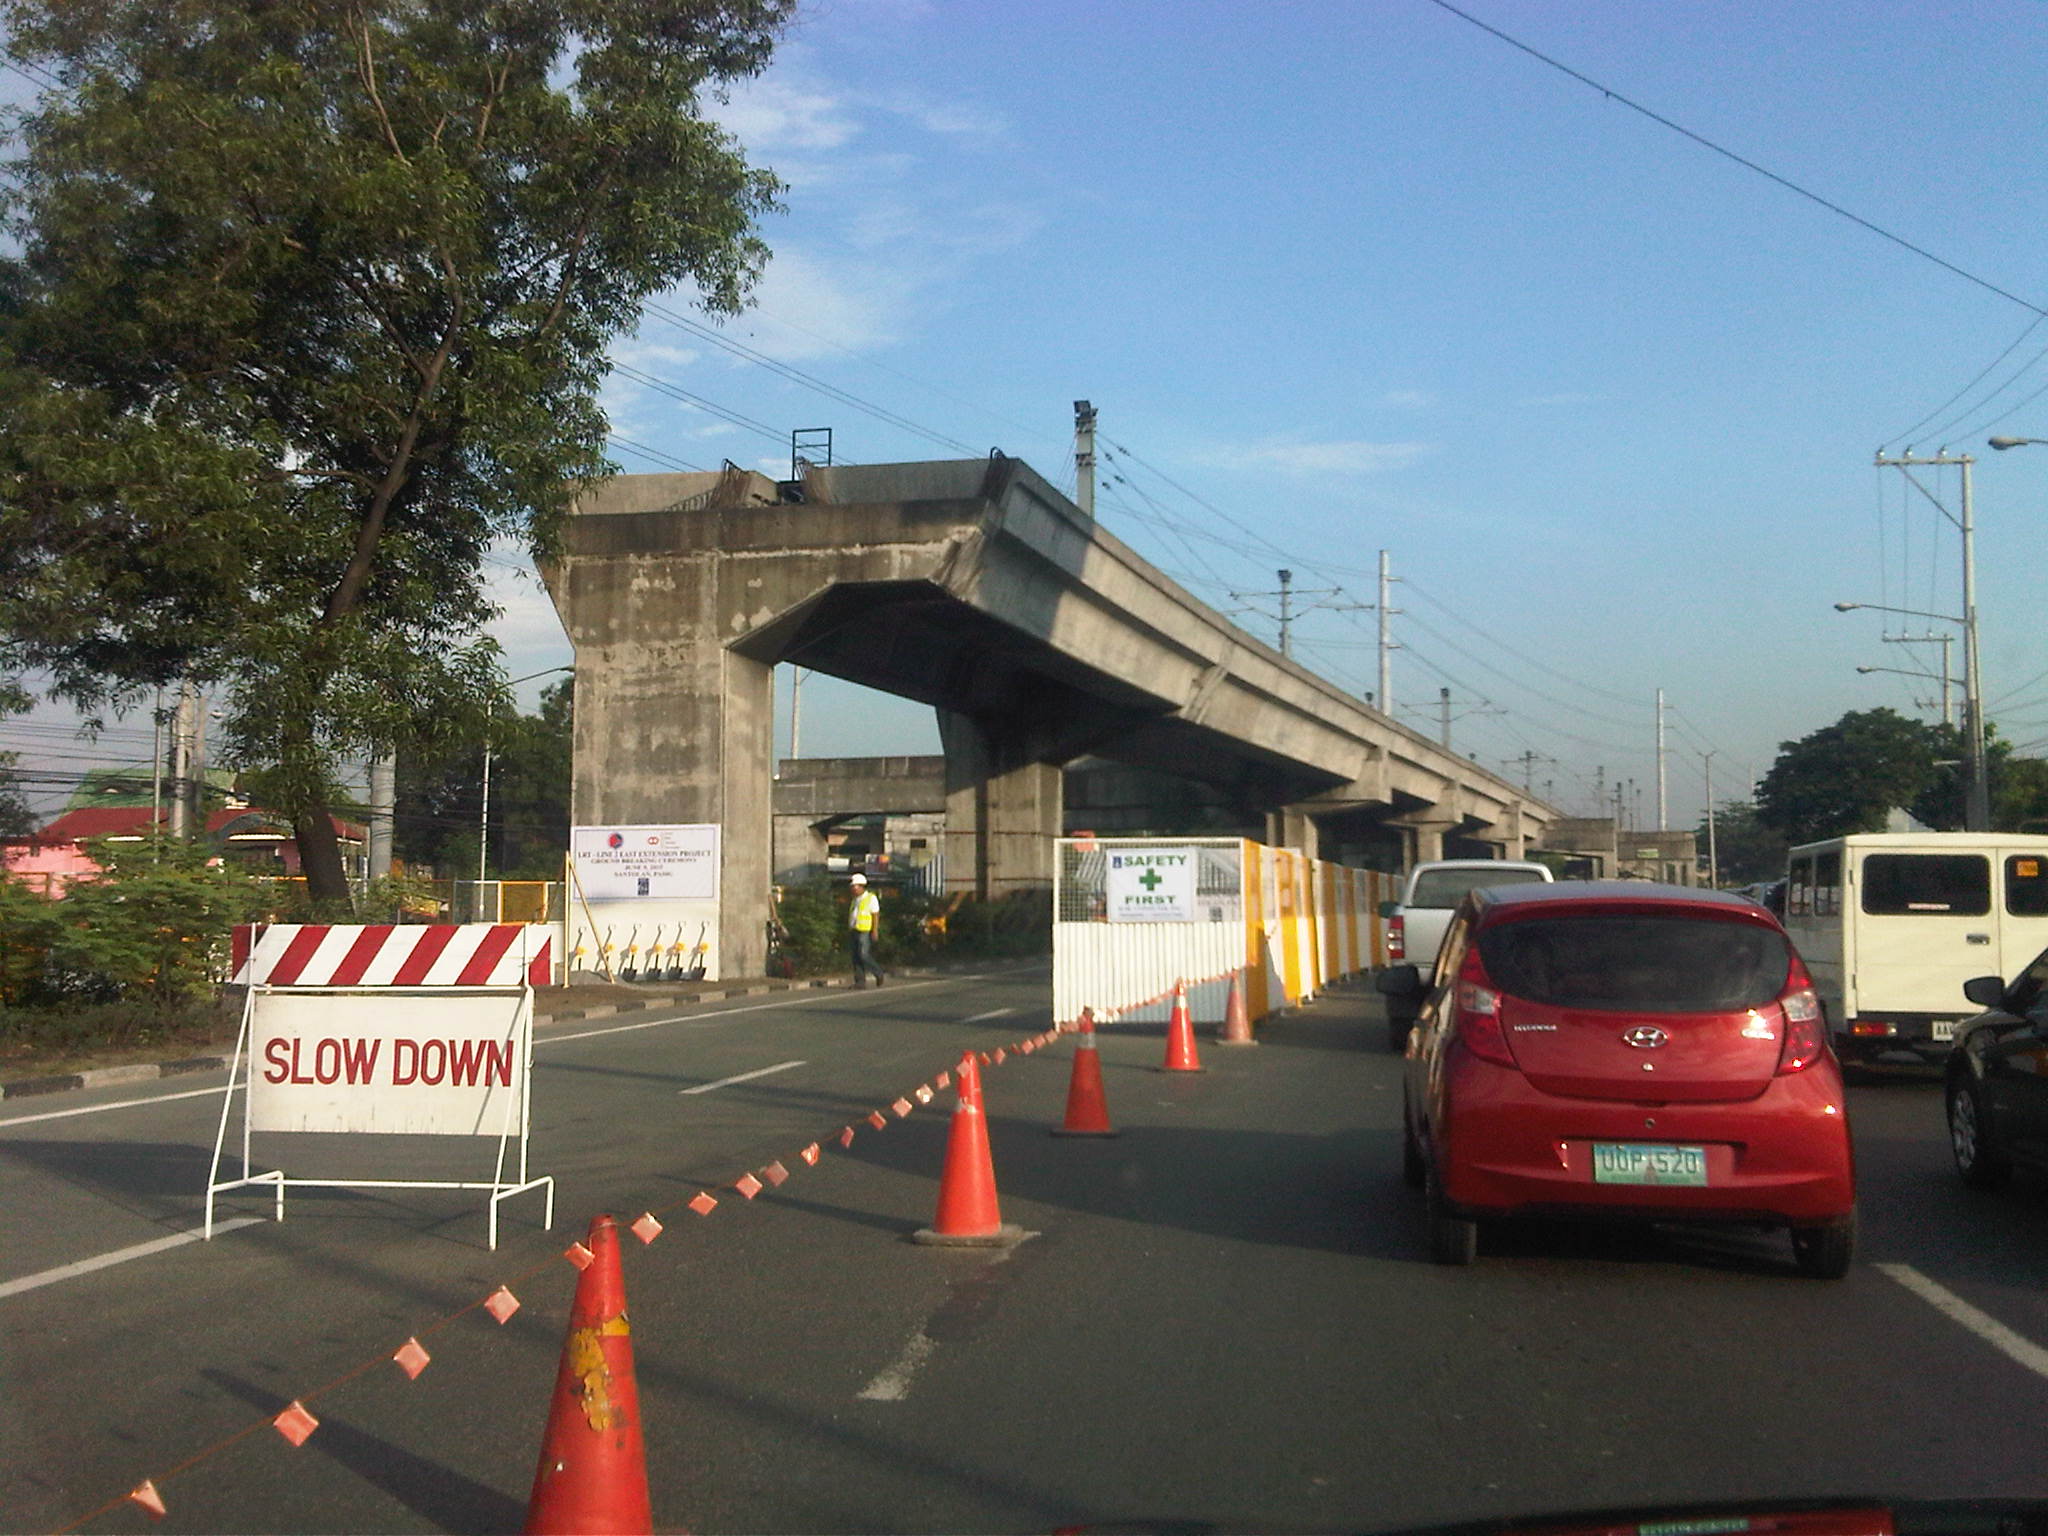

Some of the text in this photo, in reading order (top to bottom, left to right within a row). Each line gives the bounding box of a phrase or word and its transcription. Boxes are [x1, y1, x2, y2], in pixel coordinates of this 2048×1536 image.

[620, 850, 637, 858] EAST
[638, 850, 678, 858] EXTENSION
[1123, 855, 1187, 866] SAFETY
[1125, 895, 1176, 904] FIRST
[264, 1037, 515, 1087] SLOW DOWN
[1657, 1152, 1697, 1174] 520
